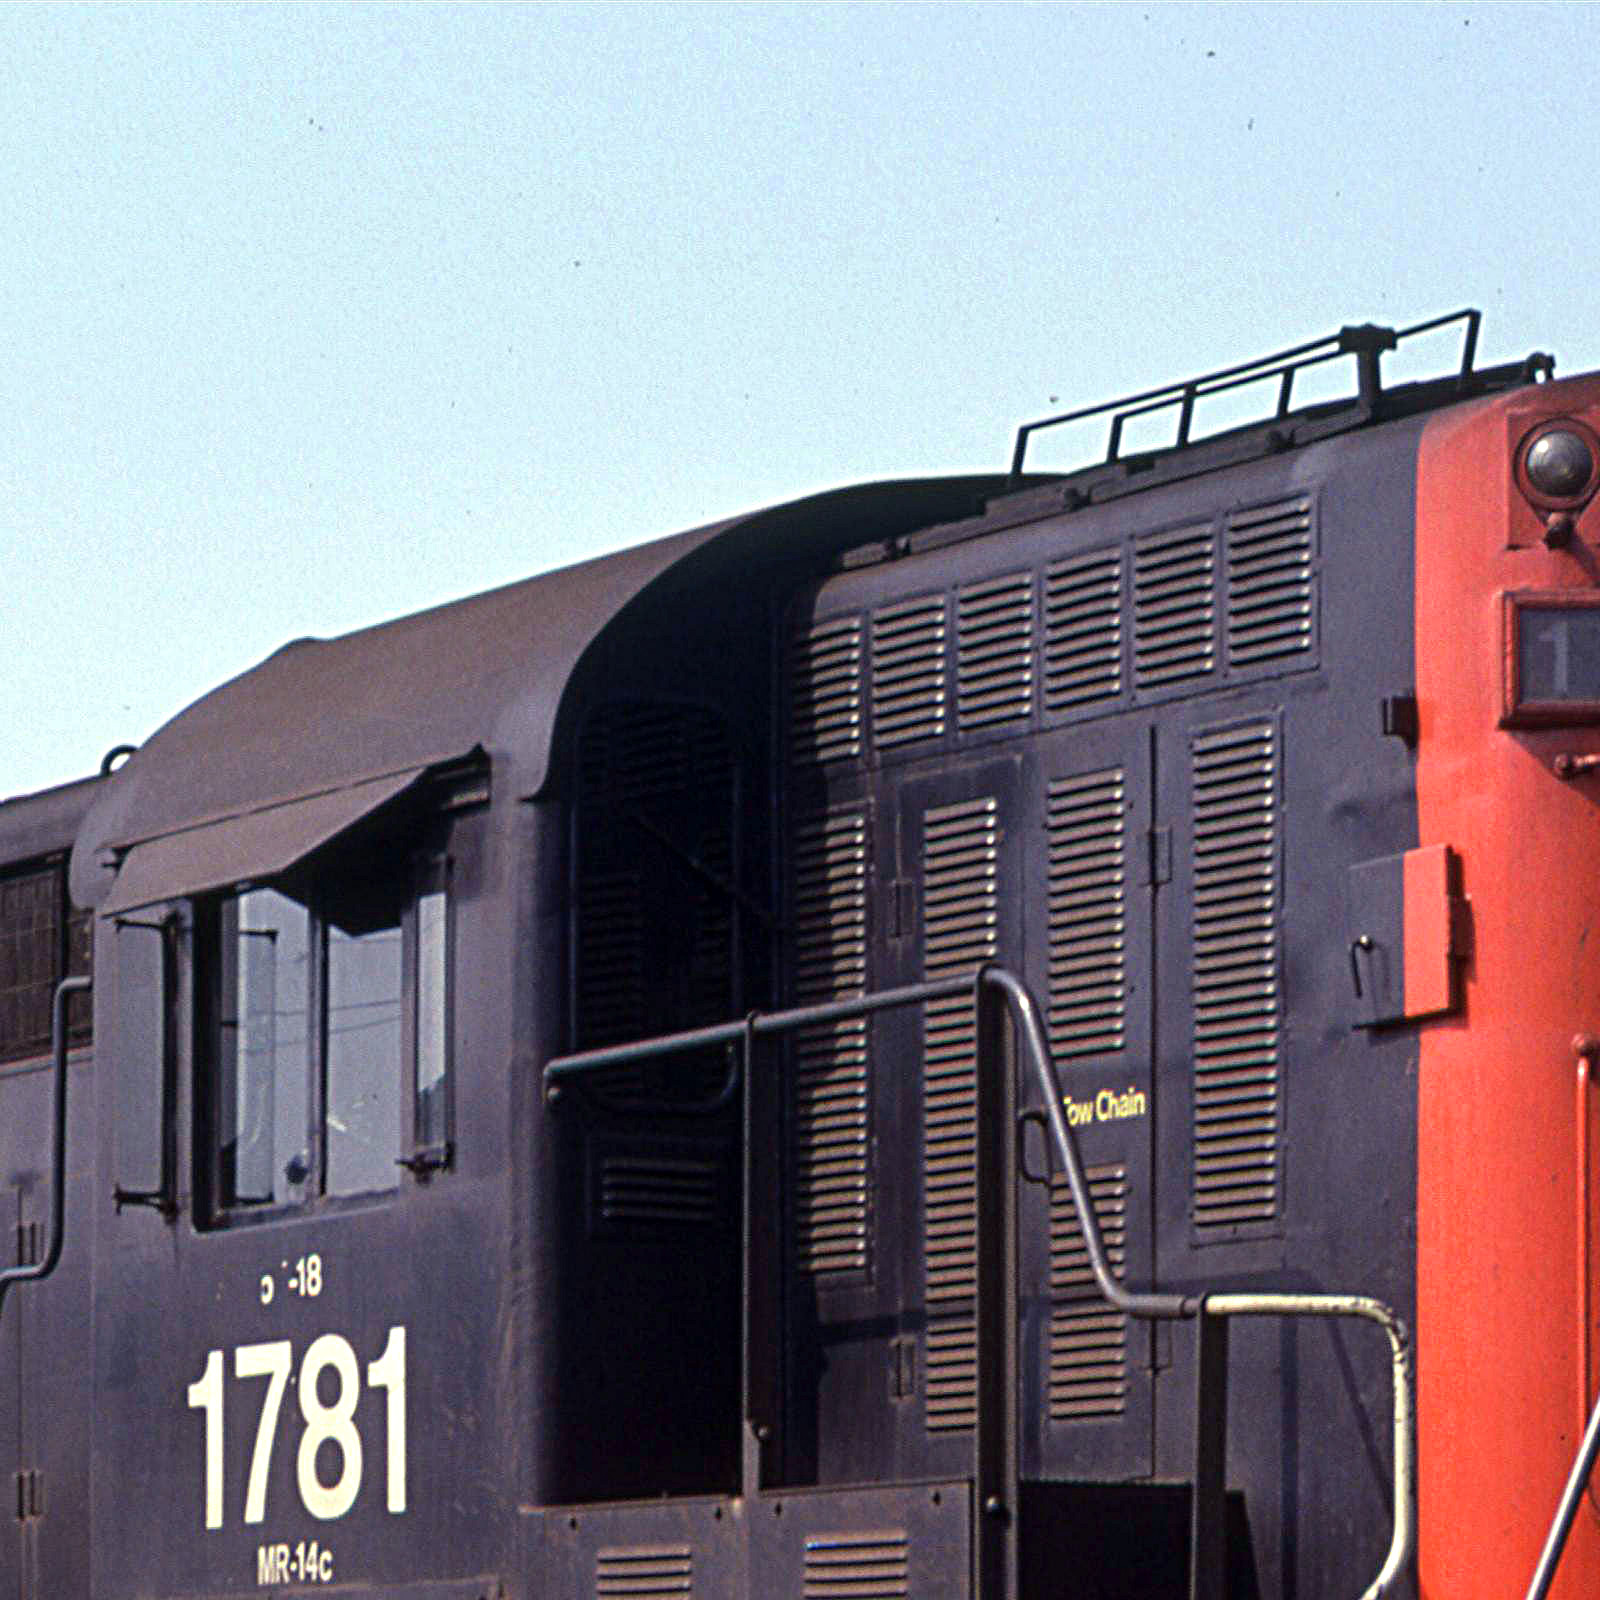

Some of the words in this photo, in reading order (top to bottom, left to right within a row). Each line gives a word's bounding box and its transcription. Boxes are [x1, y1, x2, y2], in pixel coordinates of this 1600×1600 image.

[1063, 1097, 1094, 1126] ow
[1096, 1087, 1145, 1121] Chain
[188, 1326, 406, 1530] 1781
[257, 1542, 333, 1586] MR-14c
